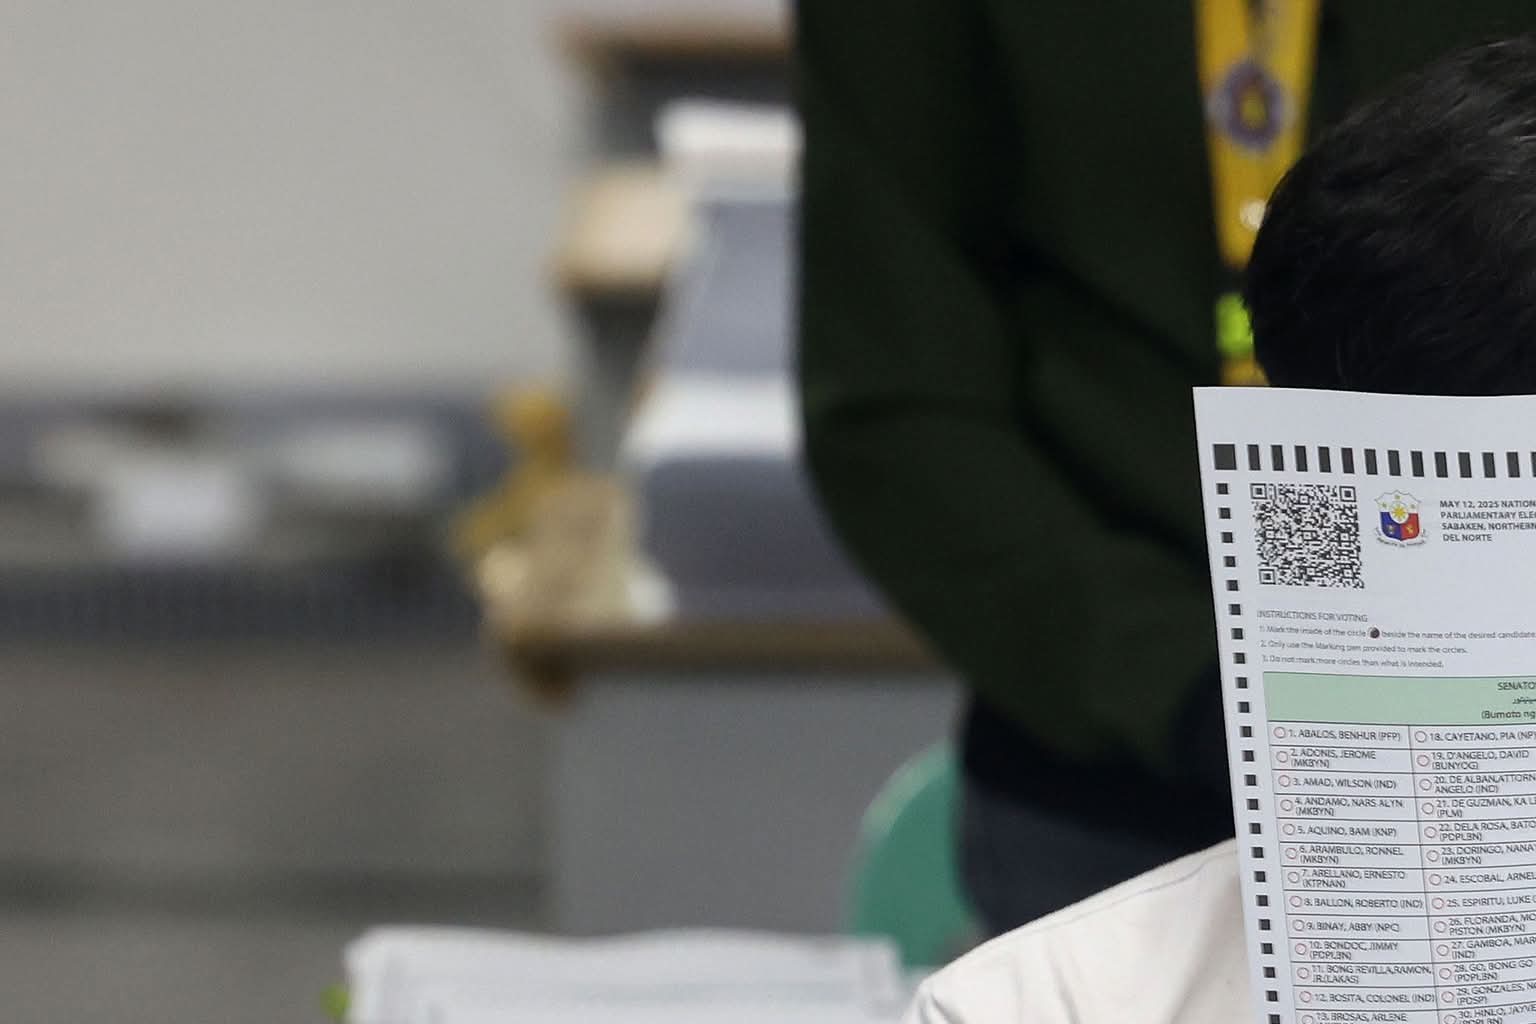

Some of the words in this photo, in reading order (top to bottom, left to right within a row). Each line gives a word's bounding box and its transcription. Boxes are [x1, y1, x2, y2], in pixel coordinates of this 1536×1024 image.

[1441, 511, 1515, 519] PARLIAMENTARY
[1489, 522, 1536, 530] NORTHERN
[1500, 732, 1516, 740] PIA
[1518, 731, 1536, 740] (NP)
